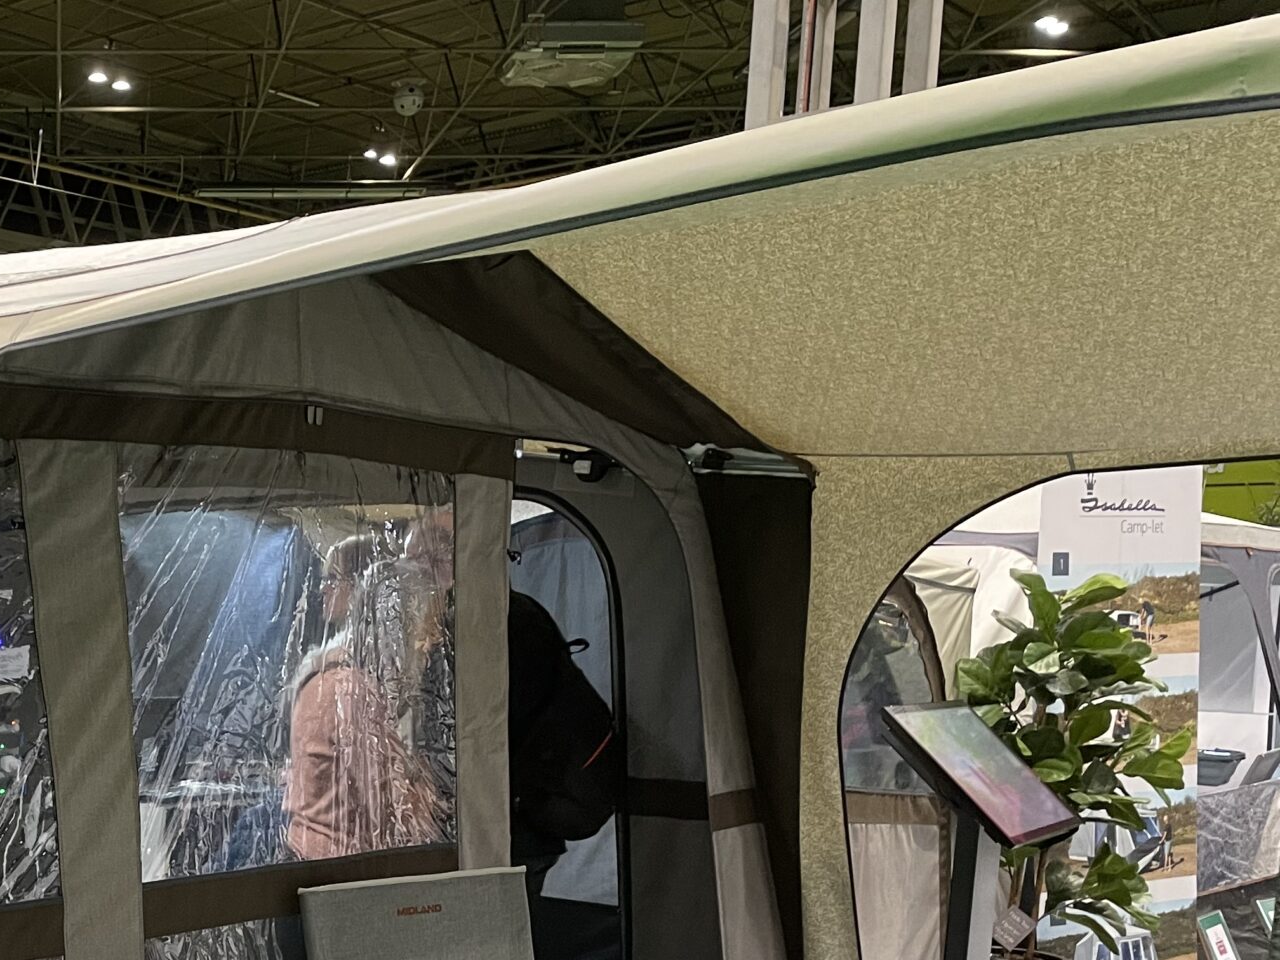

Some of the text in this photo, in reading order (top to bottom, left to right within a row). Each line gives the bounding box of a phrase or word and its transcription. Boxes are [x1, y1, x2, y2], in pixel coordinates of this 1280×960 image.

[1080, 497, 1166, 513] Isabella
[1120, 519, 1165, 537] Camp-let
[396, 903, 443, 917] MIDLAND
